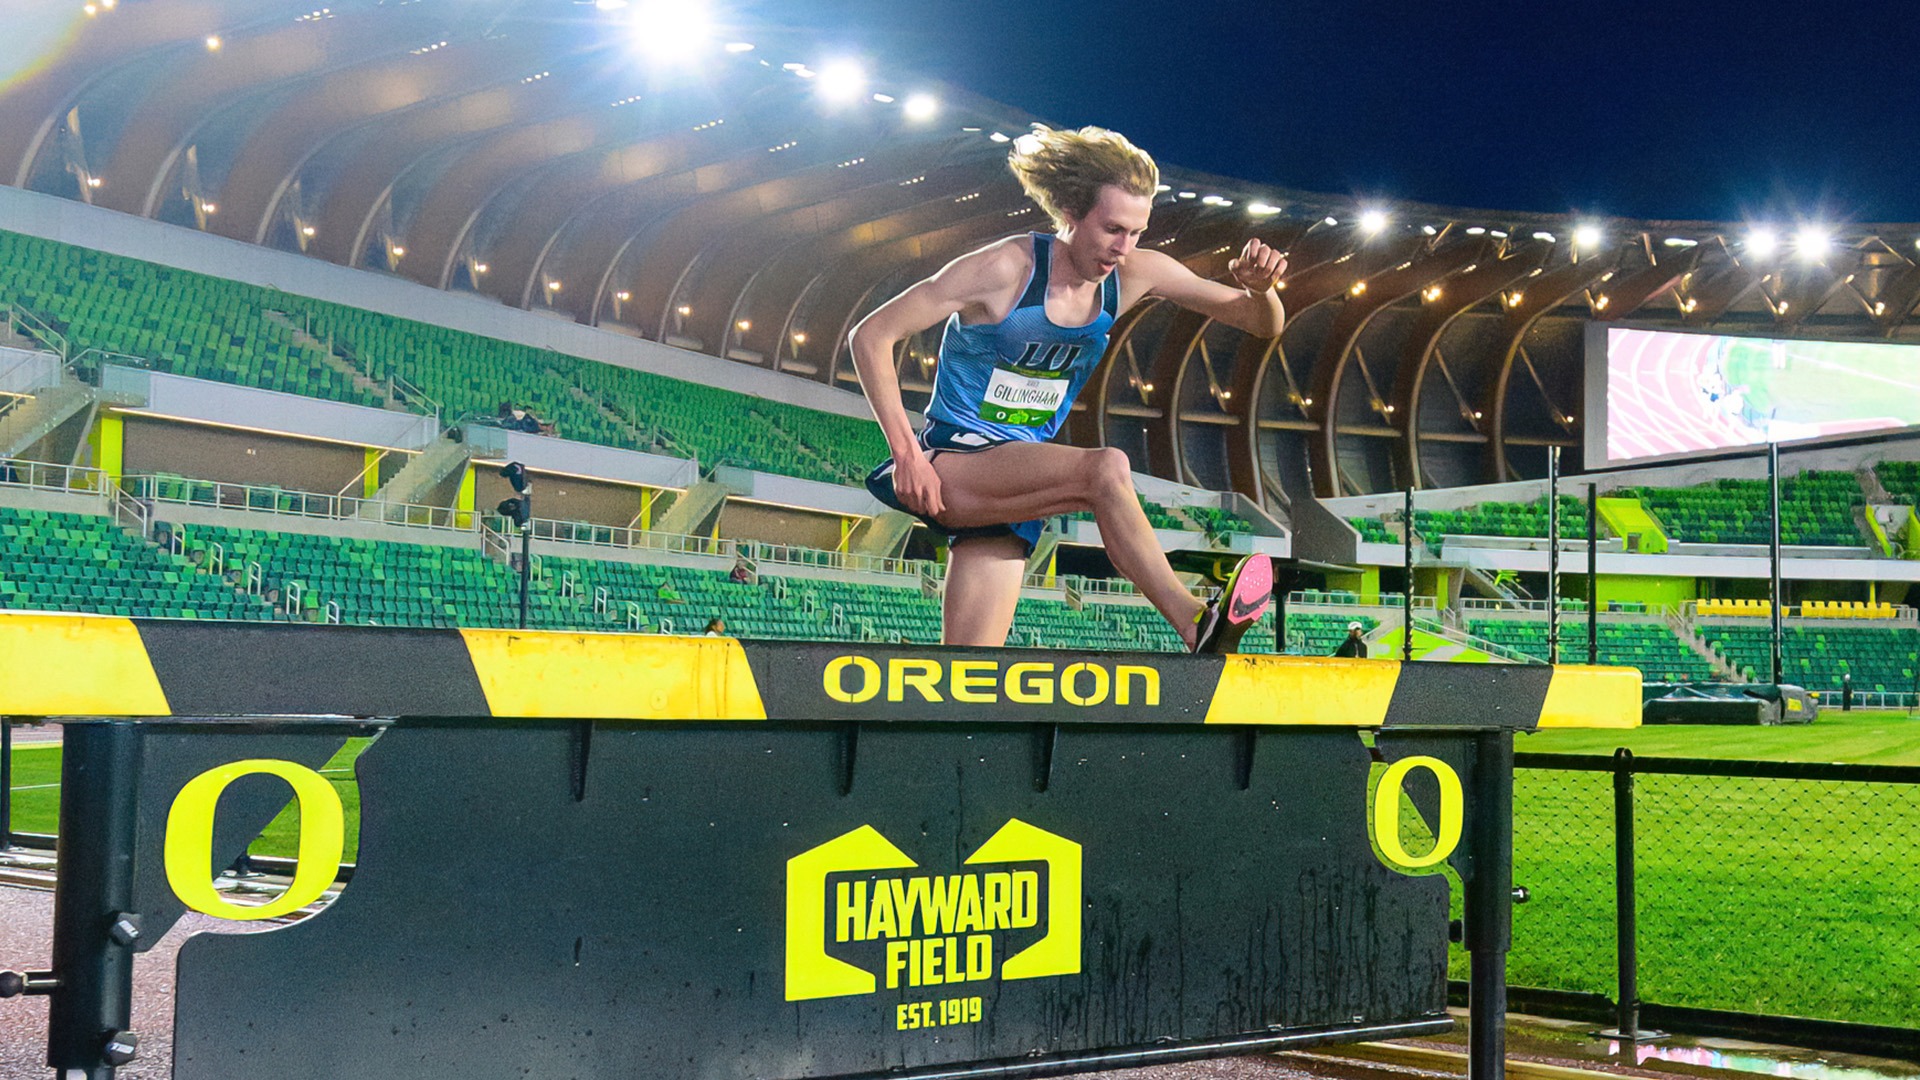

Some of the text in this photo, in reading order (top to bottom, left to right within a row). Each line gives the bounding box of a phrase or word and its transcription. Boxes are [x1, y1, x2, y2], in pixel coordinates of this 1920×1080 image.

[993, 384, 1060, 406] GILLINGHAM
[823, 655, 1161, 706] OREGON
[164, 758, 344, 921] O
[1374, 756, 1464, 868] O
[835, 870, 1039, 942] HAYWARD
[886, 934, 993, 989] FIELD
[896, 996, 982, 1031] EST. 1919
